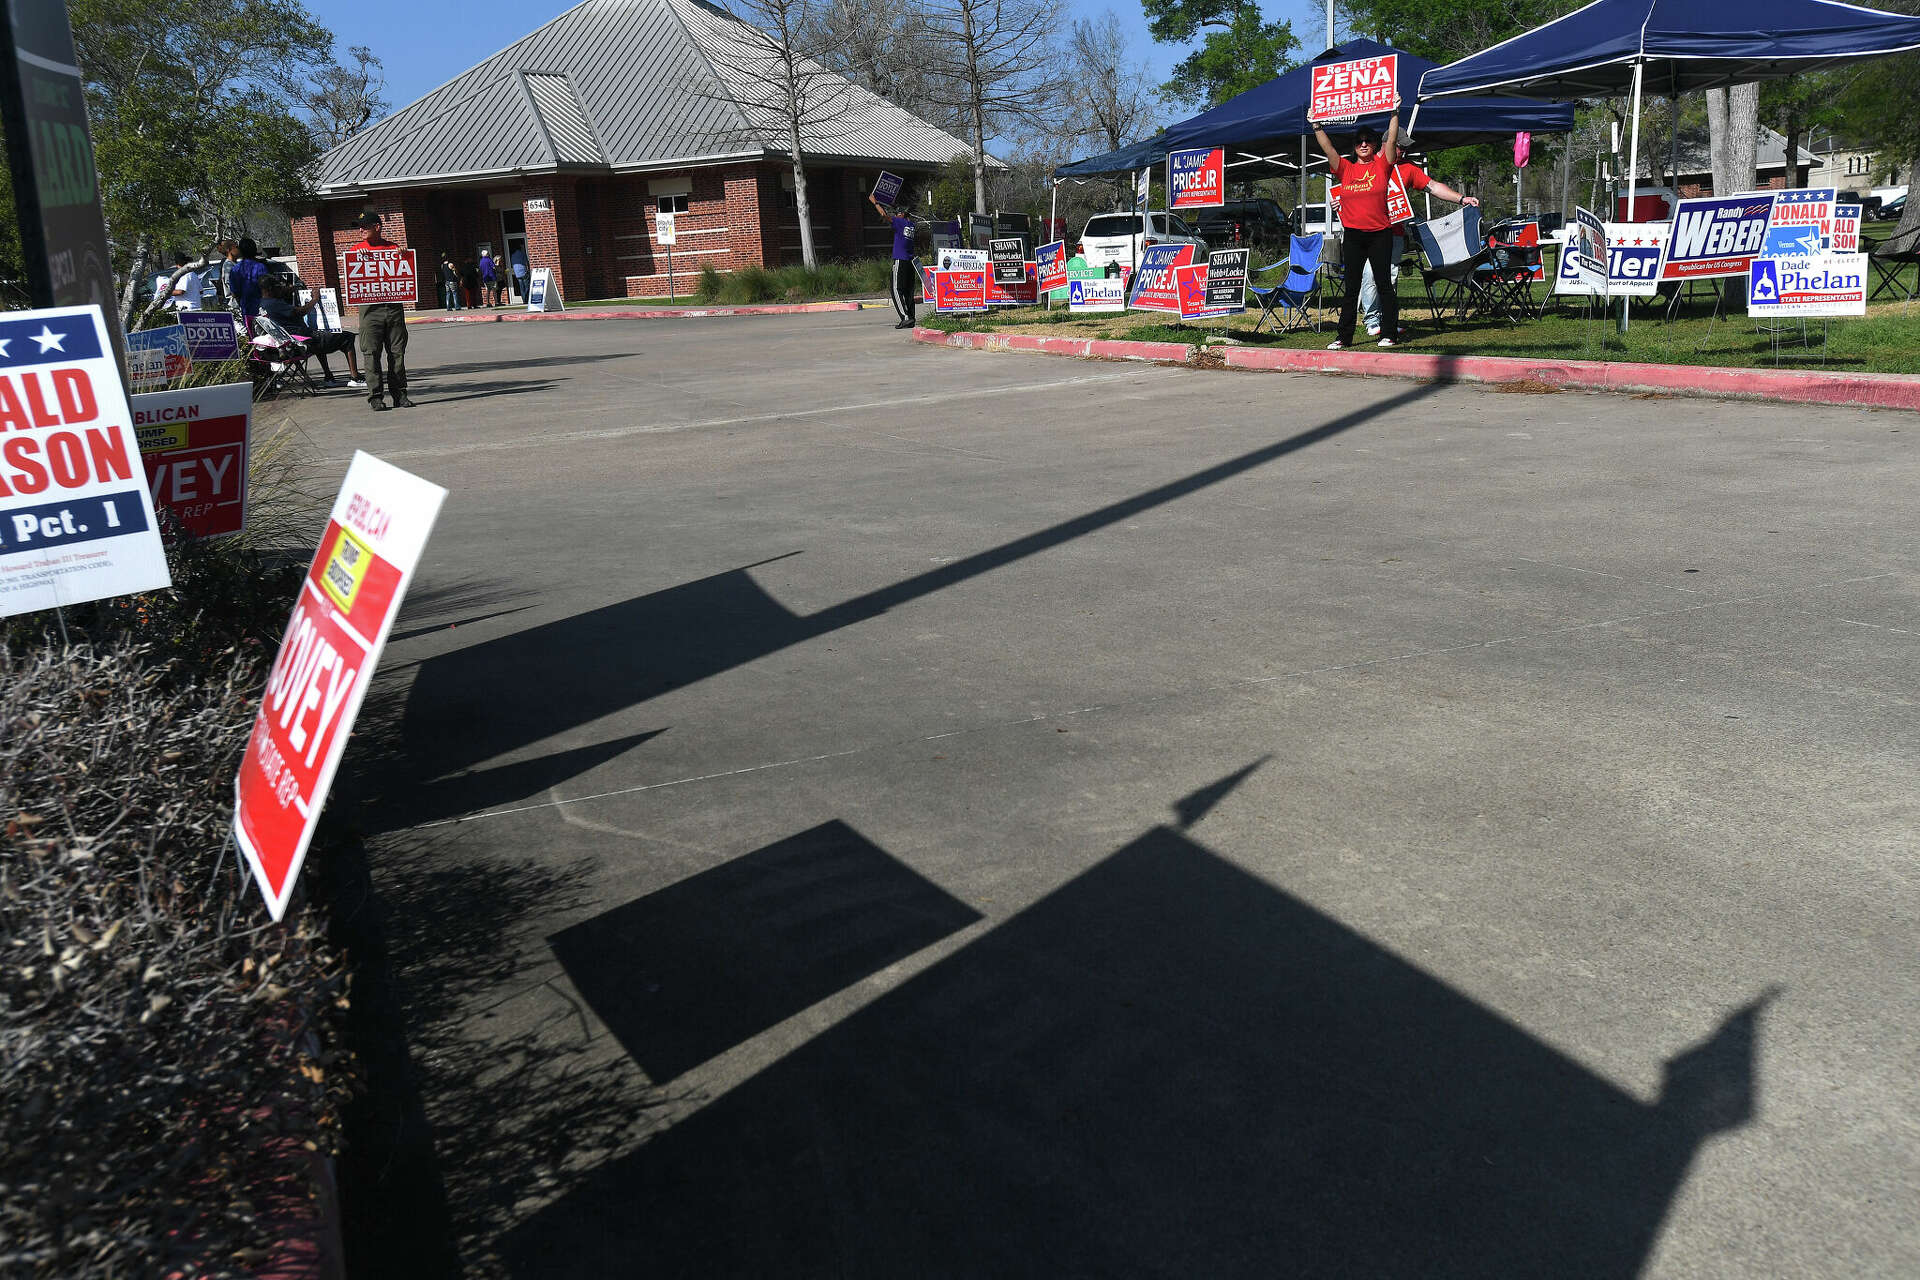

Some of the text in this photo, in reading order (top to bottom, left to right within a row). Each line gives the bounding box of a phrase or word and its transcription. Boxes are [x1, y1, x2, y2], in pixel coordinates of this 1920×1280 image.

[1316, 67, 1391, 92] ZENA
[1315, 88, 1392, 108] SHERIFF
[1359, 98, 1391, 107] COUNTY
[1174, 156, 1182, 169] AL
[1174, 169, 1217, 190] PRICE JR
[1717, 207, 1744, 219] Randy
[1772, 203, 1827, 220] DONALD
[1673, 210, 1765, 258] WEBER
[994, 241, 1018, 251] SHAWN
[1832, 235, 1856, 249] SON
[1213, 252, 1241, 265] SHAWN
[1563, 249, 1657, 277] Siler
[1679, 262, 1706, 271] Republican
[1721, 260, 1742, 269] Congress
[1781, 260, 1810, 271] Dade
[348, 260, 414, 278] ZENA
[1039, 263, 1056, 279] PRICE
[1057, 260, 1065, 274] JR
[1068, 270, 1094, 278] ERVICE
[1137, 269, 1169, 289] PRICE
[1629, 280, 1654, 288] Appeals
[1781, 271, 1861, 291] Phelan
[349, 281, 414, 293] SHERIFF
[1084, 287, 1121, 298] Phelan
[1803, 294, 1861, 302] REPRESENTATIVE
[187, 327, 230, 340] DOYLE
[0, 426, 133, 498] SON
[183, 503, 214, 518] REP
[12, 509, 88, 542] Pct.
